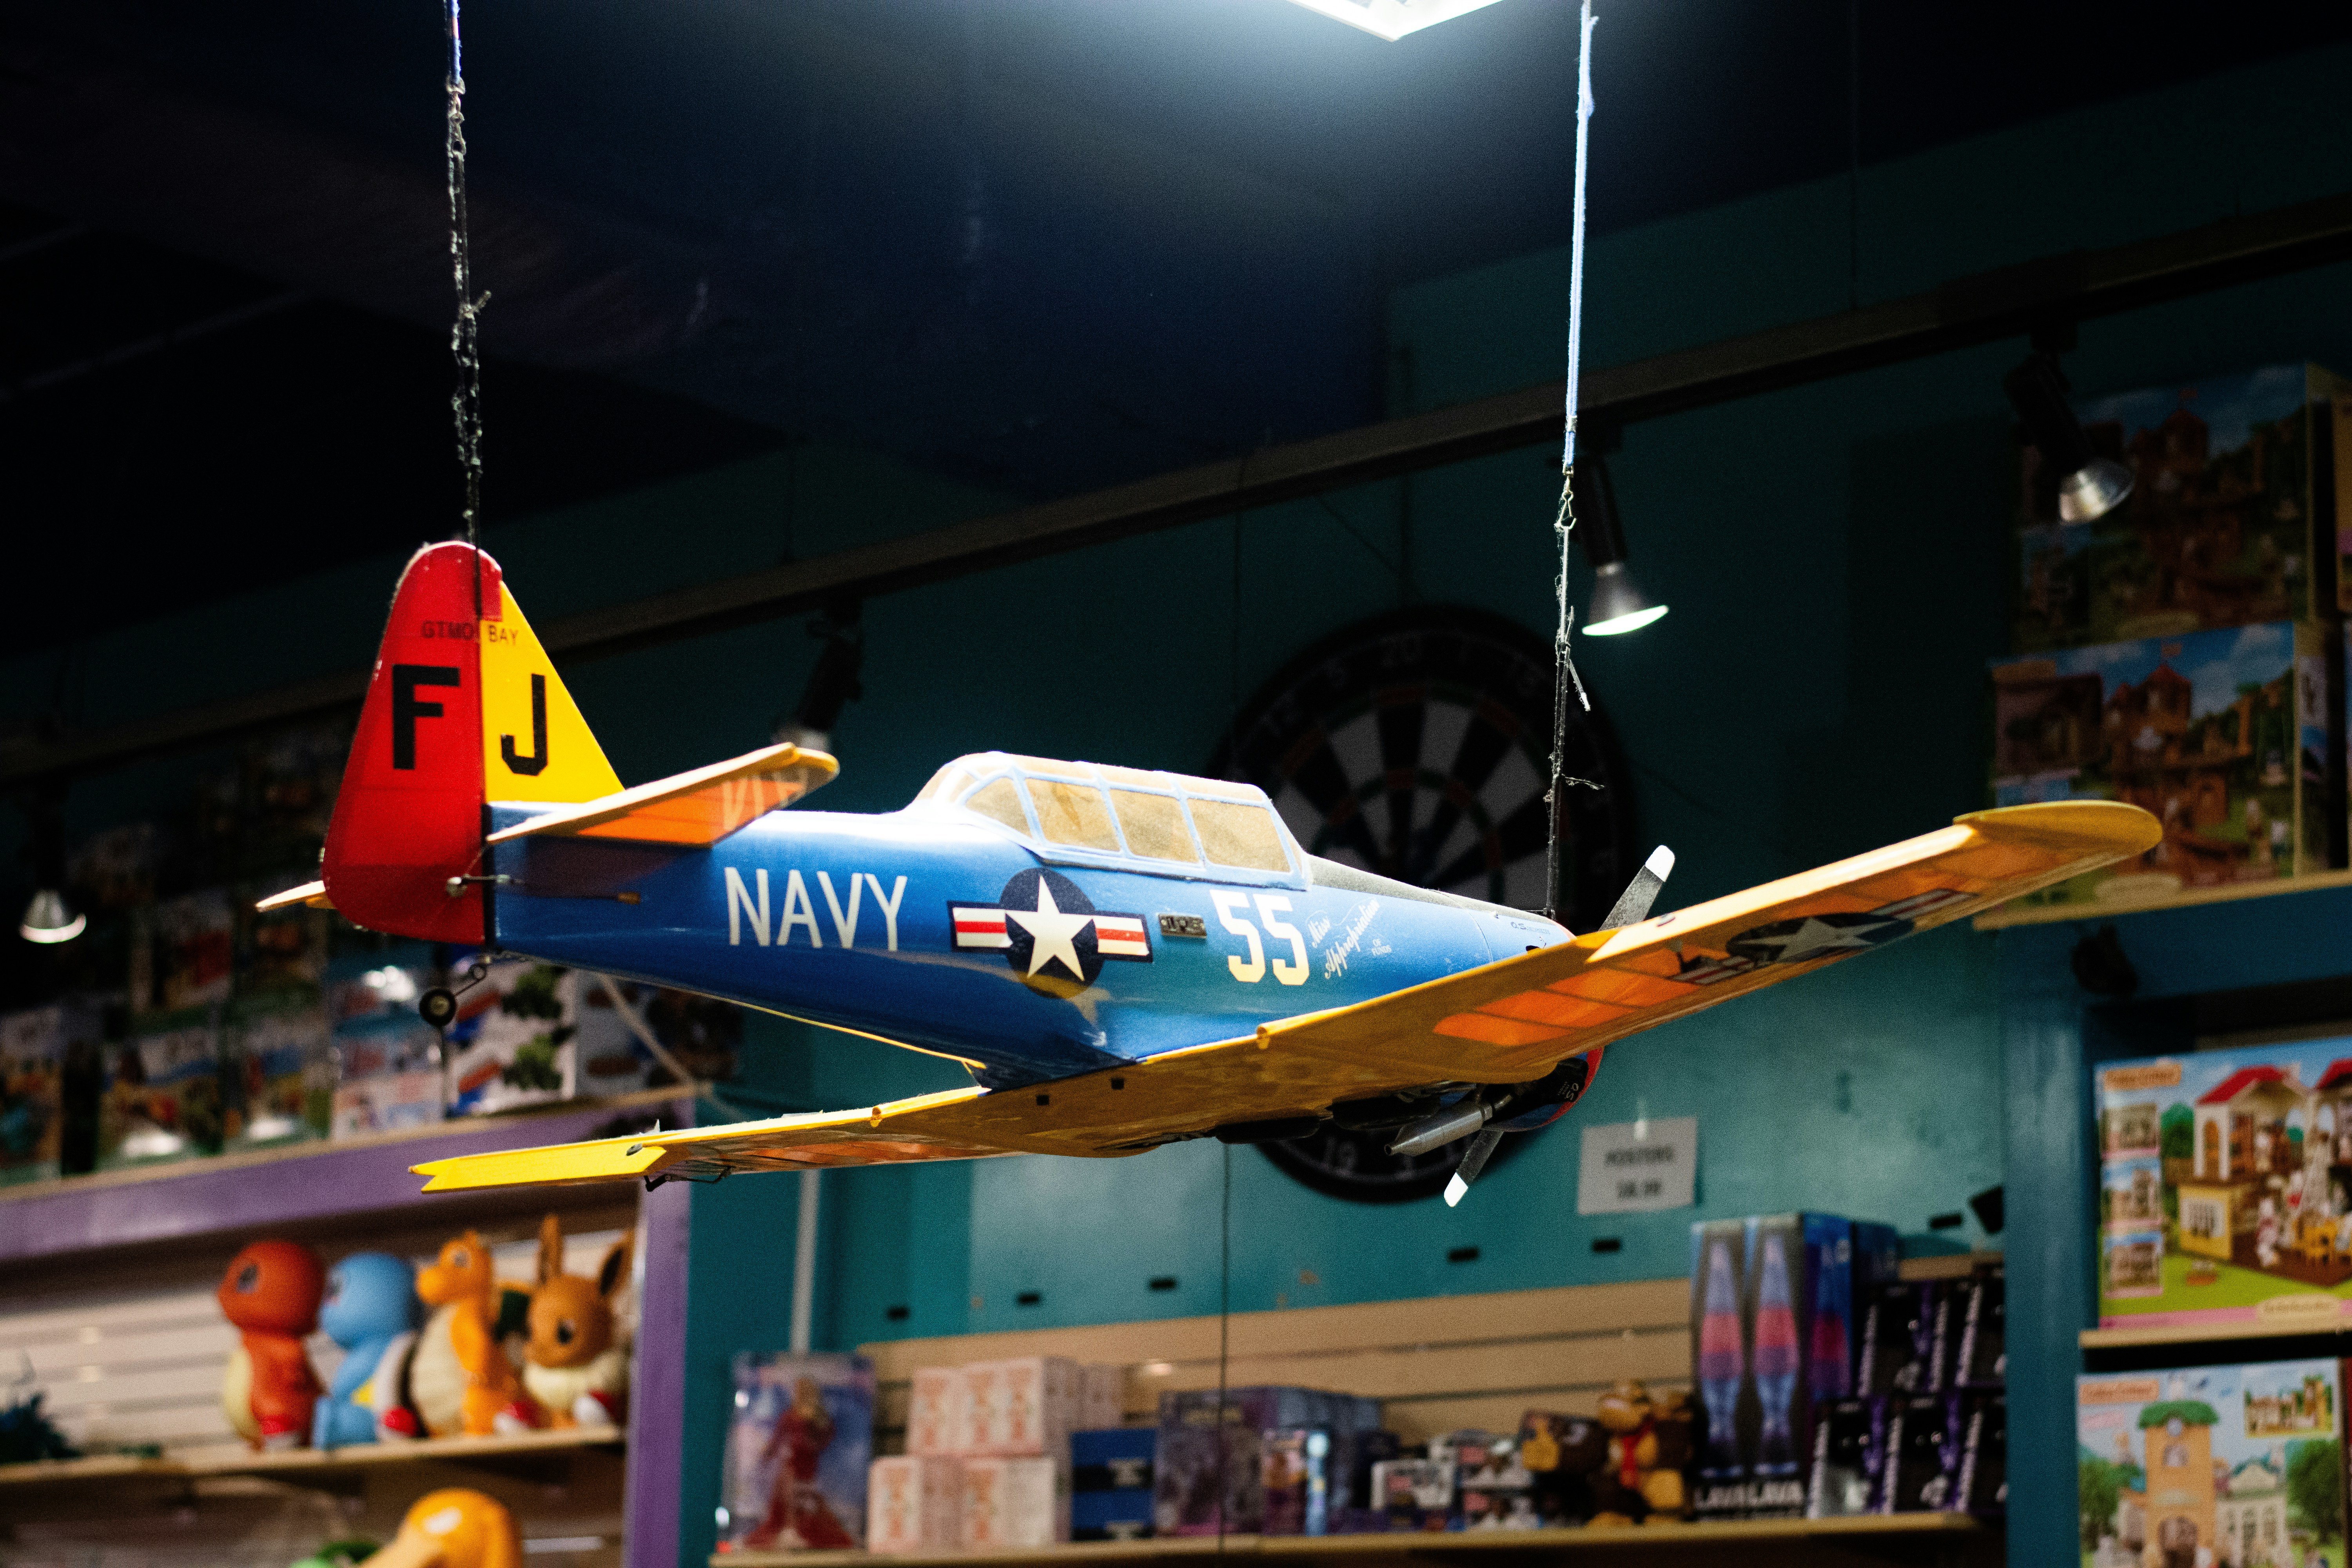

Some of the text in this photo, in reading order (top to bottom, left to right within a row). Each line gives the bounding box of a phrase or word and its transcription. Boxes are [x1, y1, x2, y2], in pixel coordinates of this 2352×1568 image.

[421, 620, 519, 645] GTMO BAY
[1380, 631, 1423, 669] 20
[392, 664, 461, 769] F
[501, 674, 549, 777] J
[724, 866, 908, 952] NAVY
[1208, 889, 1312, 986] 55
[1371, 944, 1392, 956] FUNDS
[1372, 938, 1383, 947] OF
